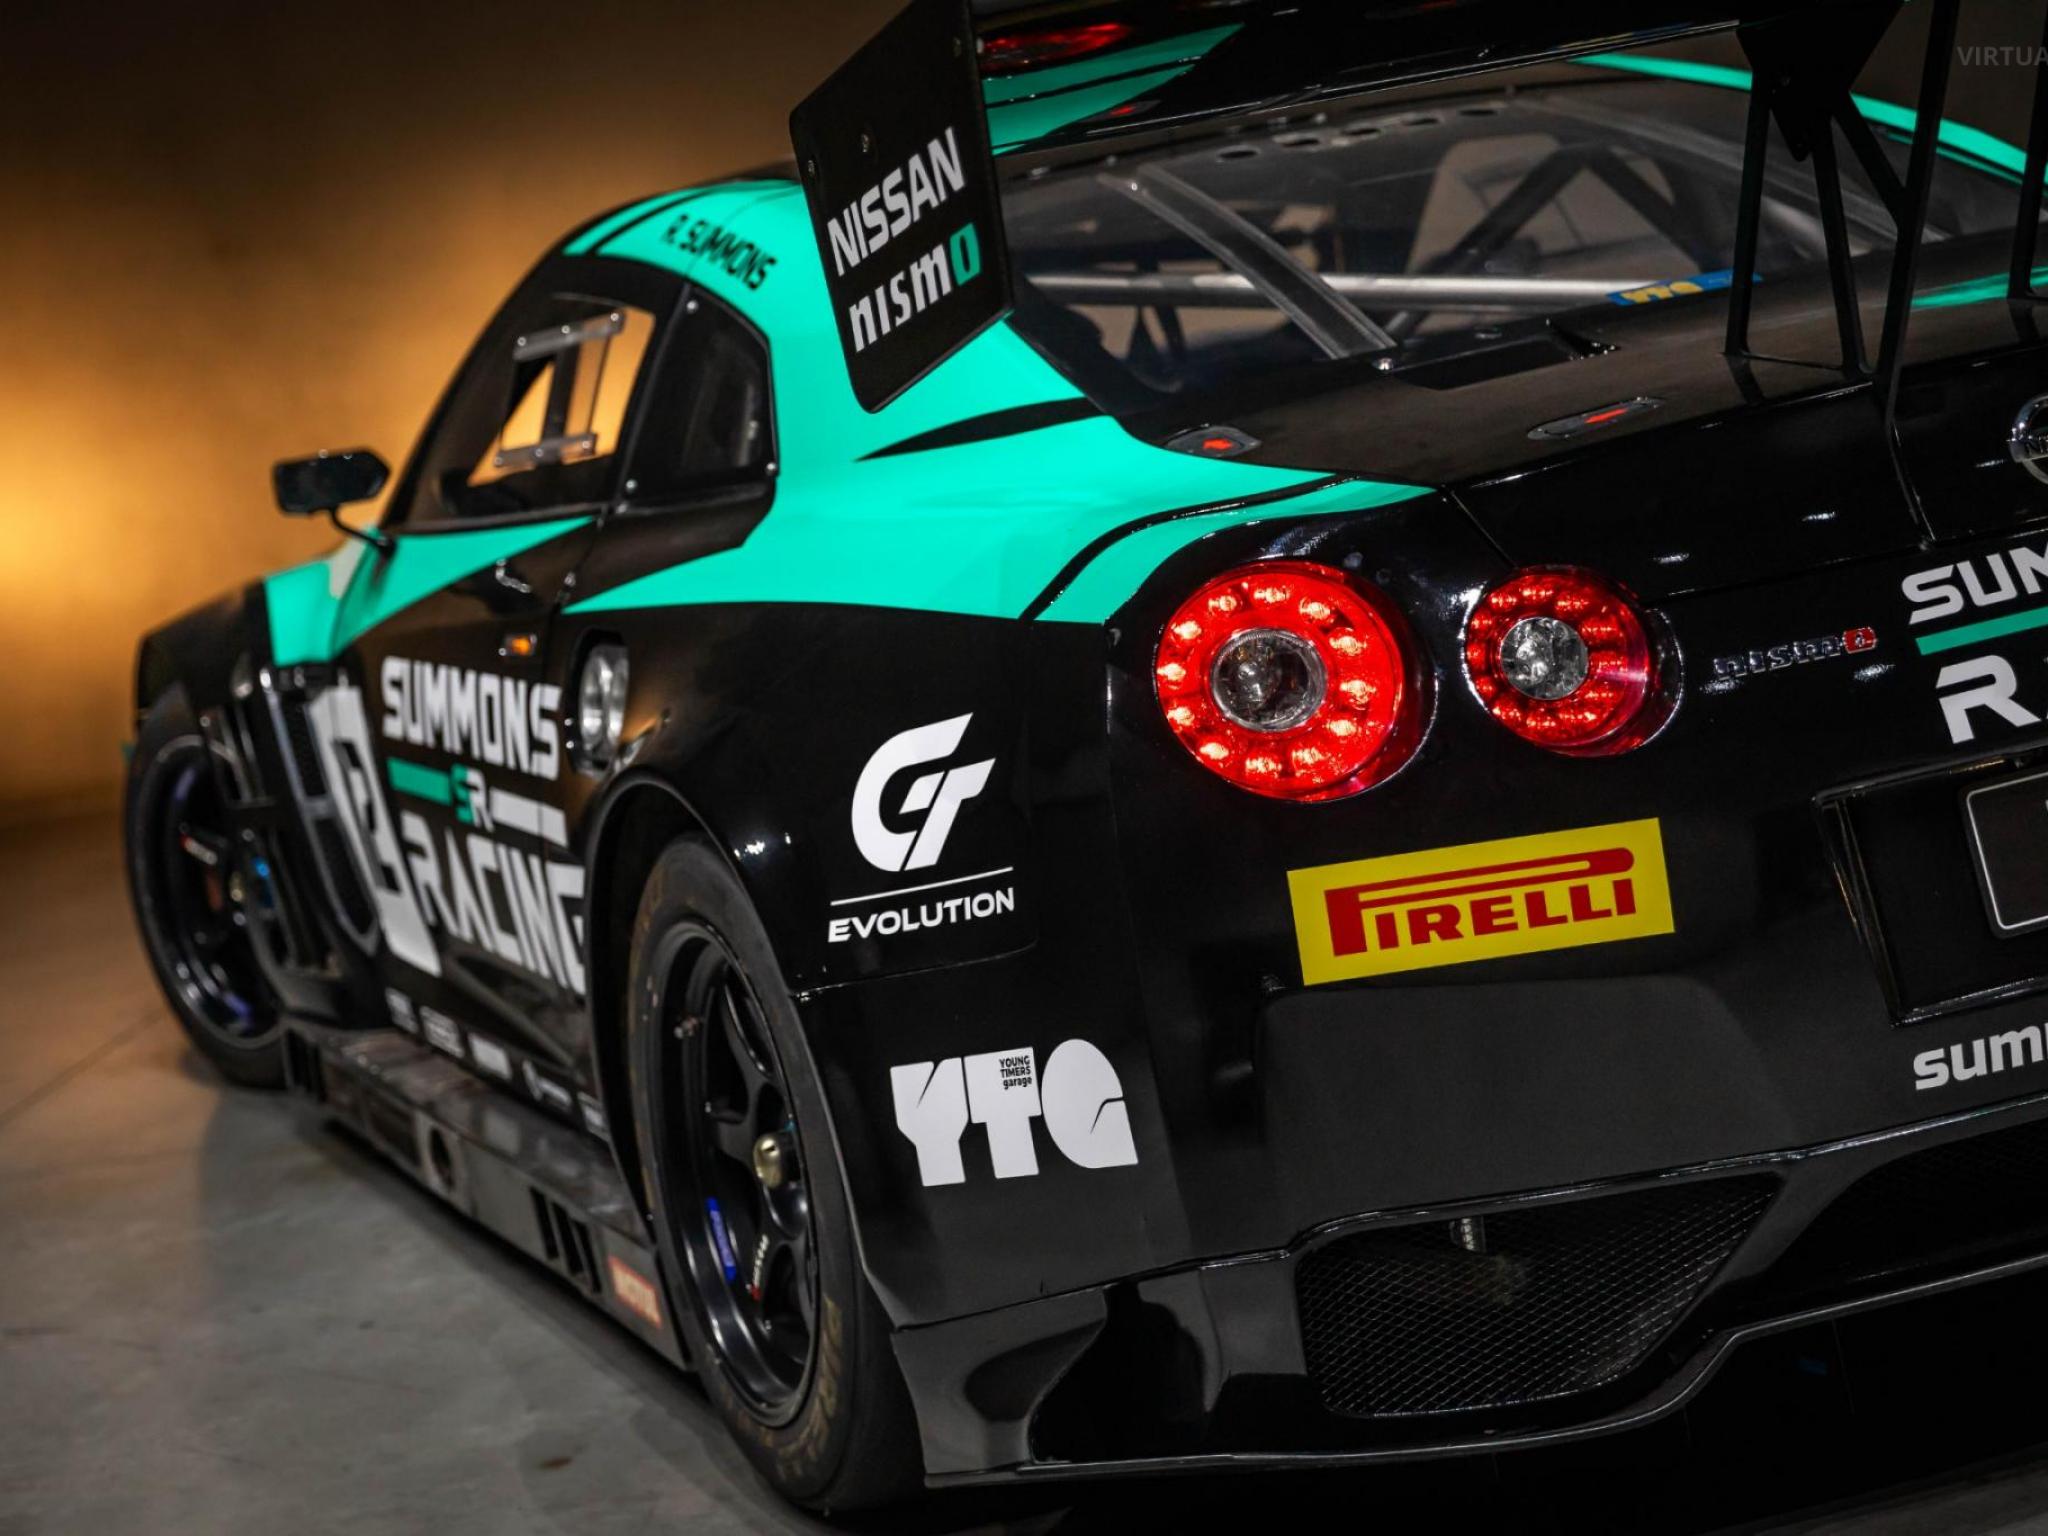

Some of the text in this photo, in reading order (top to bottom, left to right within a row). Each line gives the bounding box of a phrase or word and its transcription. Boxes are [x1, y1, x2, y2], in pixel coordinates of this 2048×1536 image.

[826, 126, 966, 278] NISSAN
[686, 219, 777, 290] SUMMONS
[849, 222, 981, 353] nismo
[381, 654, 563, 781] SUMMONS
[1935, 654, 2048, 744] R
[851, 712, 996, 872] GT
[400, 809, 586, 996] RACING
[827, 887, 1015, 944] EVOLUTION
[1324, 847, 1637, 957] PIRELLI
[999, 1055, 1030, 1068] YOUNG
[1000, 1066, 1031, 1078] TIMERS
[1003, 1077, 1032, 1090] garage
[1913, 1022, 2048, 1090] sum
